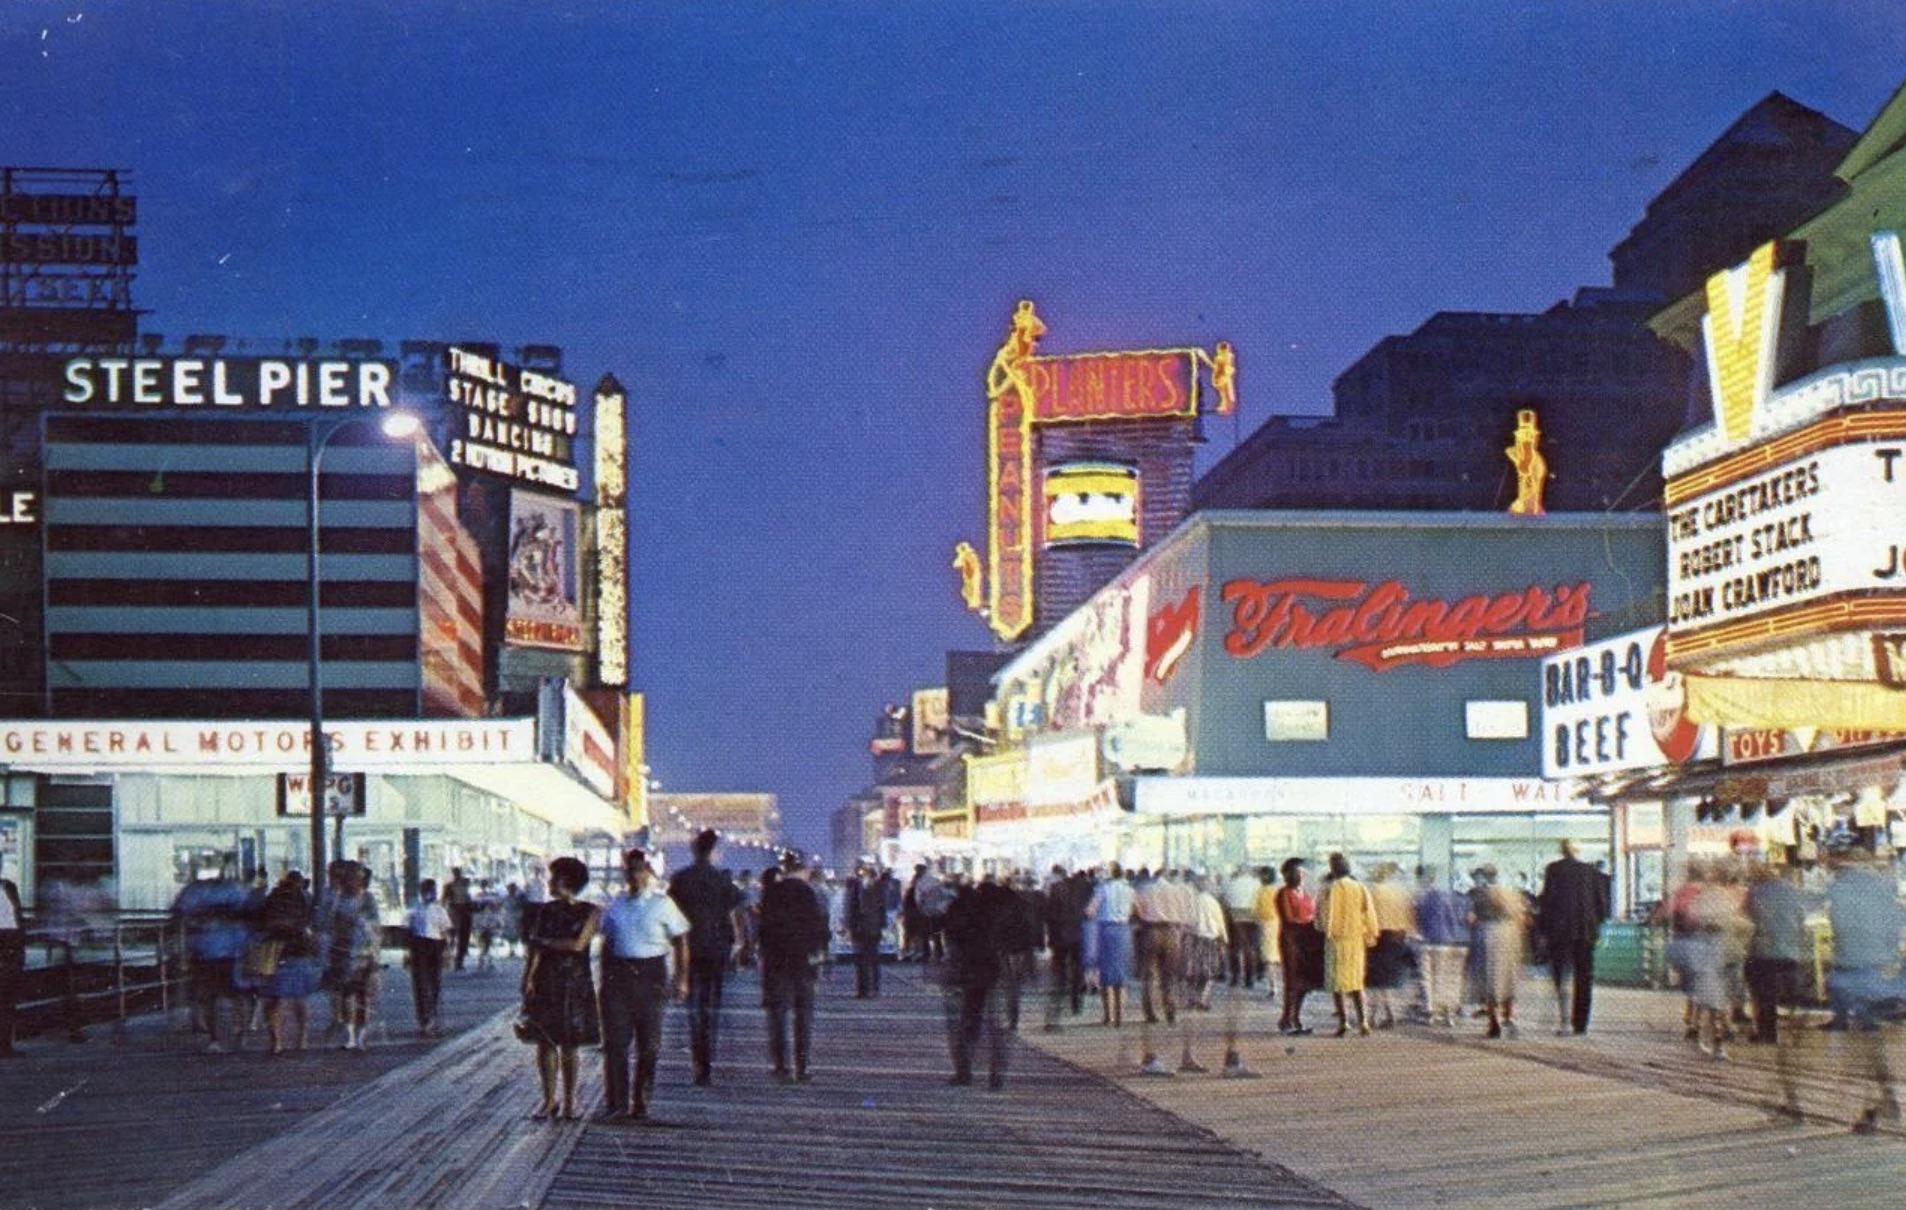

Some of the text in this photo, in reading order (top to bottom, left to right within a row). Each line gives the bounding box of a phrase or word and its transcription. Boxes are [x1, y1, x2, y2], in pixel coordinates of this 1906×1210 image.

[64, 357, 391, 407] STEEL PIER
[450, 377, 509, 417] STAGE
[1029, 355, 1182, 412] PLANTERS
[0, 492, 35, 523] E
[1670, 461, 1820, 543] THE CARETAKERS
[1680, 511, 1814, 580] ROBERT STACK
[1872, 545, 1906, 579] J
[1670, 555, 1821, 625] JOAN CRAWFORD
[1221, 578, 1591, 660] Fralinger's
[5, 731, 178, 753] GENERAL
[365, 730, 512, 751] EXHIBIT
[1555, 710, 1632, 768] BEEF
[1729, 728, 1784, 760] TOYS
